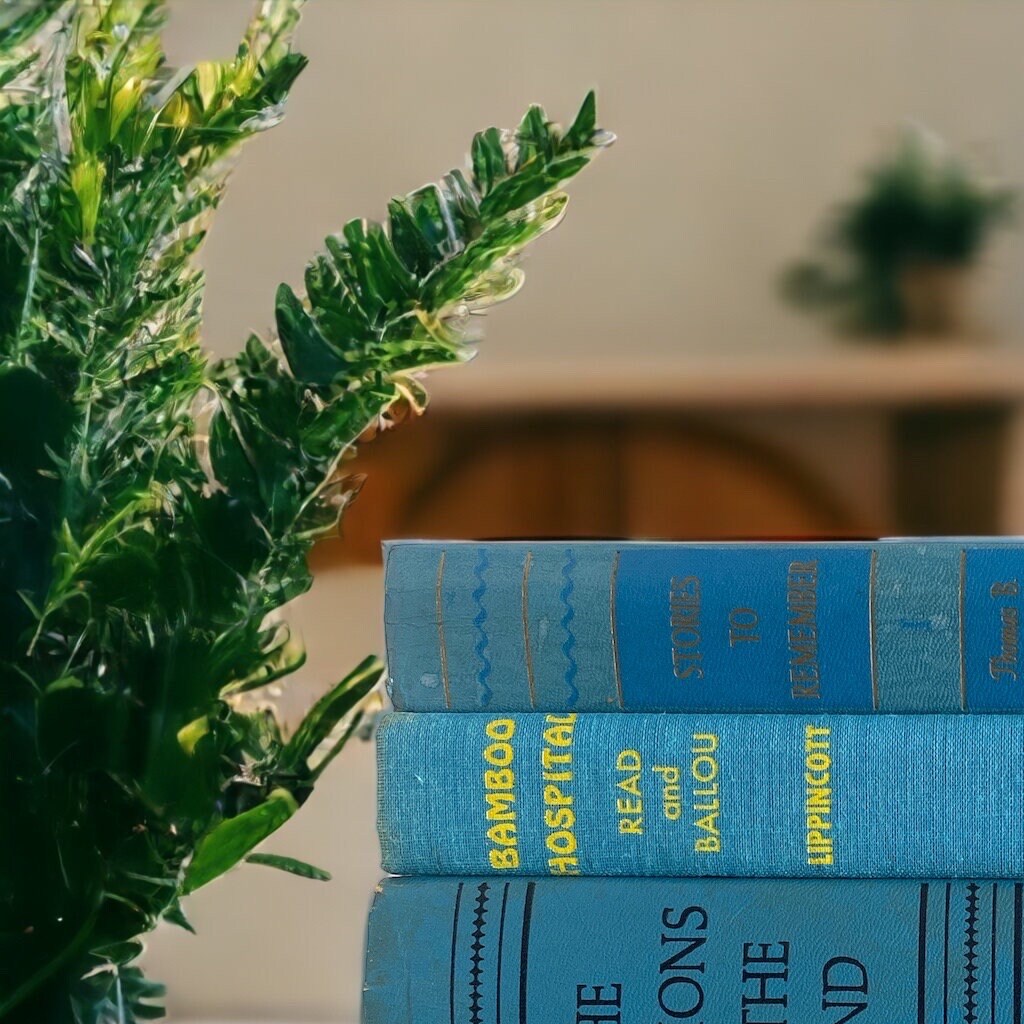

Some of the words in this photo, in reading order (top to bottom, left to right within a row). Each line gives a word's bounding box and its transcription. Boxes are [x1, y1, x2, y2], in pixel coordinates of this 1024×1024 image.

[670, 575, 703, 679] STORIES
[729, 608, 760, 648] TO
[787, 559, 821, 699] REMEMBER
[484, 718, 520, 869] BAMBOO
[542, 712, 580, 875] HOSPITAL
[616, 748, 643, 835] READ
[652, 766, 681, 820] and
[692, 733, 721, 853] BALLOU
[805, 724, 834, 867] LIPPINCOTT
